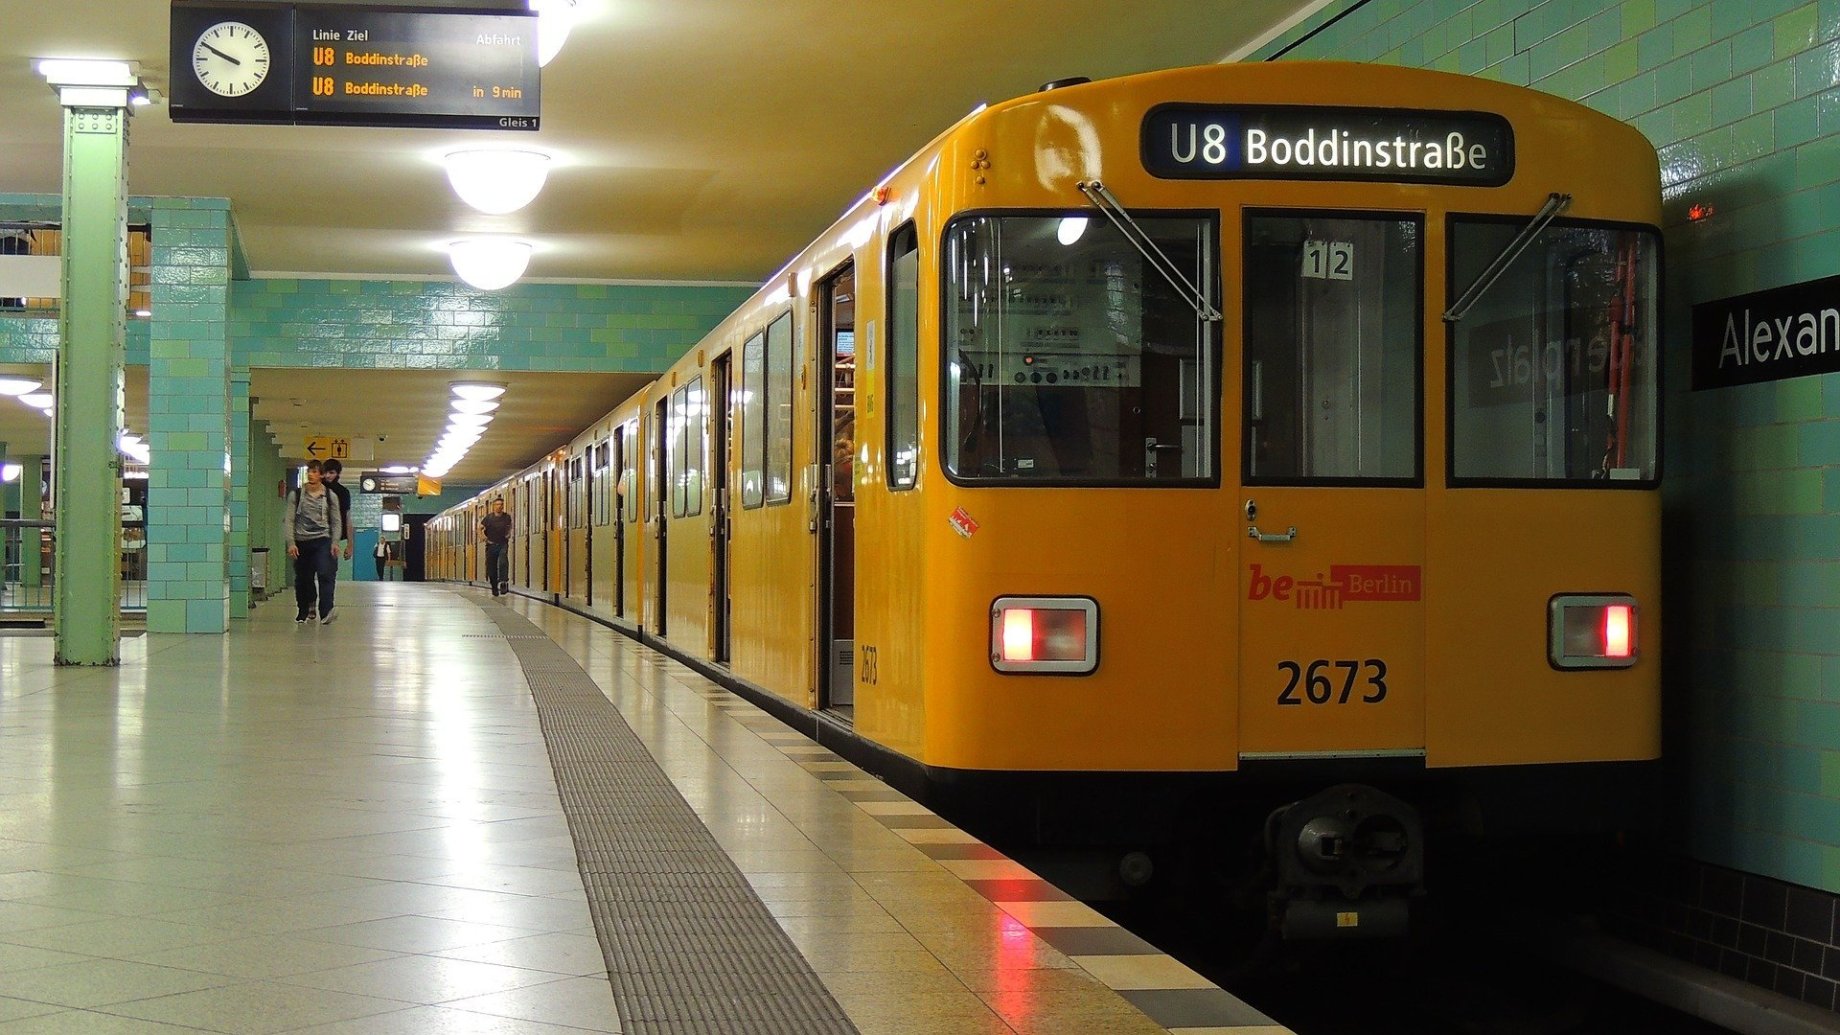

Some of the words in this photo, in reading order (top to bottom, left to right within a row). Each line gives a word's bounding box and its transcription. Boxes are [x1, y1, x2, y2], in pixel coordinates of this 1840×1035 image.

[313, 29, 341, 41] Linie
[347, 30, 369, 41] Ziel
[475, 33, 521, 46] Abfahrt
[313, 47, 335, 66] U8
[346, 52, 429, 68] Boddinstraße
[312, 77, 335, 96] U8
[345, 82, 429, 98] Boddinstraße
[473, 85, 485, 98] in
[499, 117, 528, 128] Gleis
[531, 118, 538, 128] 1
[1171, 123, 1227, 165] U8
[1246, 127, 1488, 170] Boddinstraße
[1718, 308, 1840, 369] Alexan
[1248, 564, 1294, 601] be
[1348, 573, 1413, 595] Berlin
[862, 644, 878, 686] 2673
[1277, 658, 1388, 705] 2673
